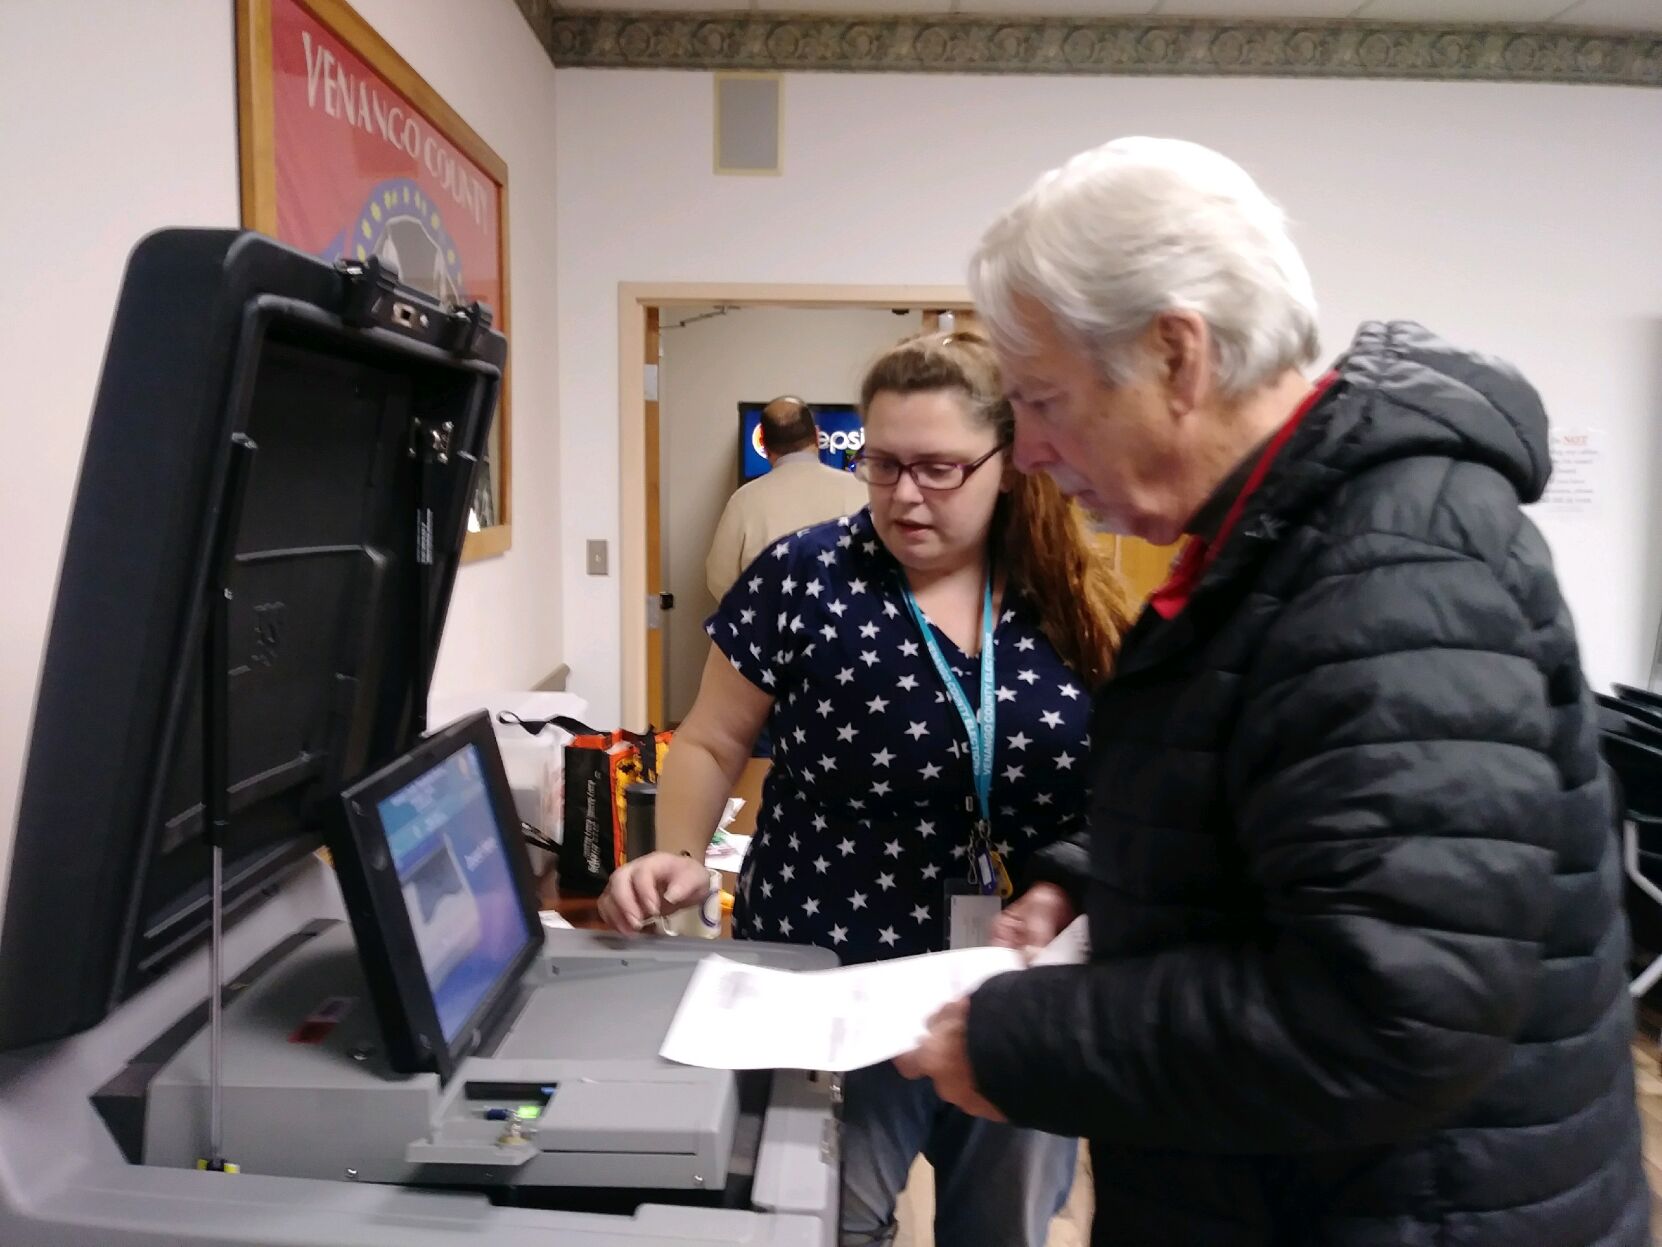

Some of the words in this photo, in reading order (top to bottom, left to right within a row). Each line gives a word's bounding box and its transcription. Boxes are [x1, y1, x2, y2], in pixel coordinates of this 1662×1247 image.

[302, 30, 420, 158] VENANGO
[424, 137, 488, 236] COUNTY
[817, 427, 866, 455] epsi
[946, 681, 971, 721] COUNTY
[983, 682, 994, 724] COUNTY
[982, 723, 994, 776] VENANGO
